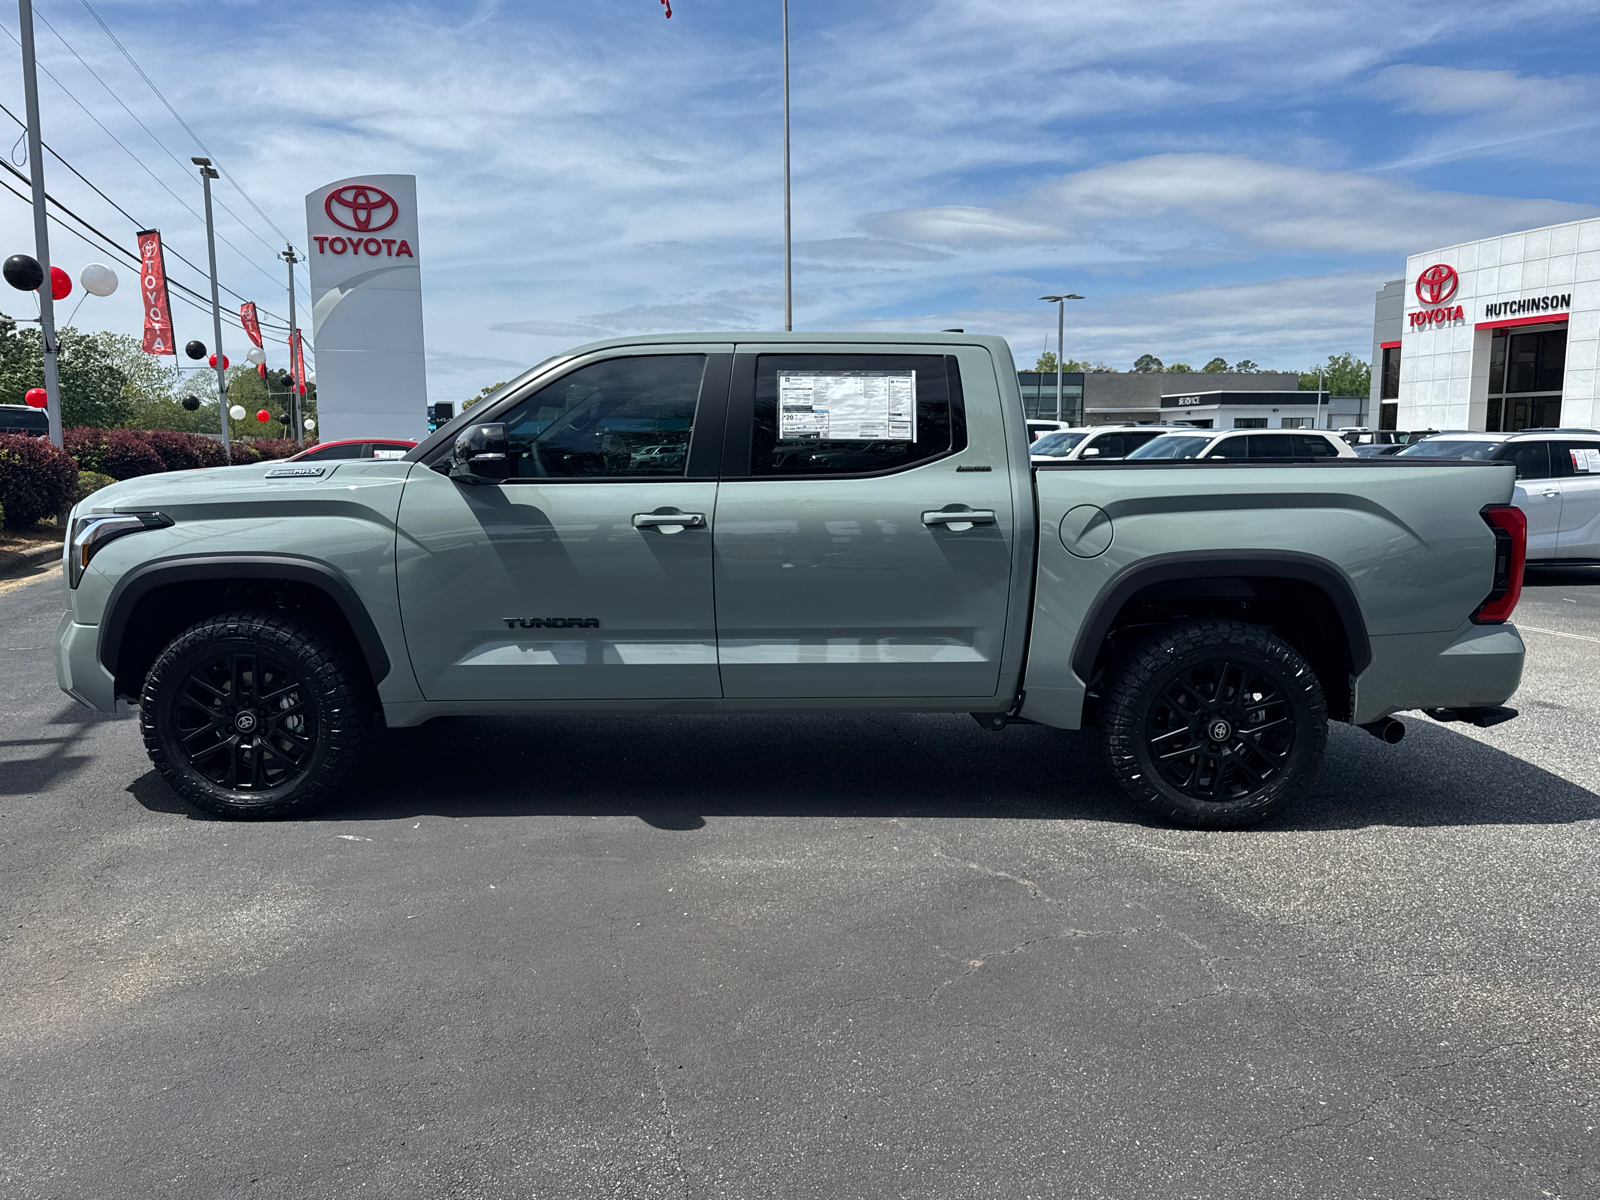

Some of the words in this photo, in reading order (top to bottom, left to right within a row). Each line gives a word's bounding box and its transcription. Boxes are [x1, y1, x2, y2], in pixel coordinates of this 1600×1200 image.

[313, 236, 413, 257] TOYOTA
[144, 260, 165, 350] TOYOTA
[1485, 293, 1571, 317] HUTCHINSON
[1408, 305, 1464, 327] TOYOTA
[1178, 396, 1201, 405] SERVICE
[503, 617, 600, 628] TUNDRA
